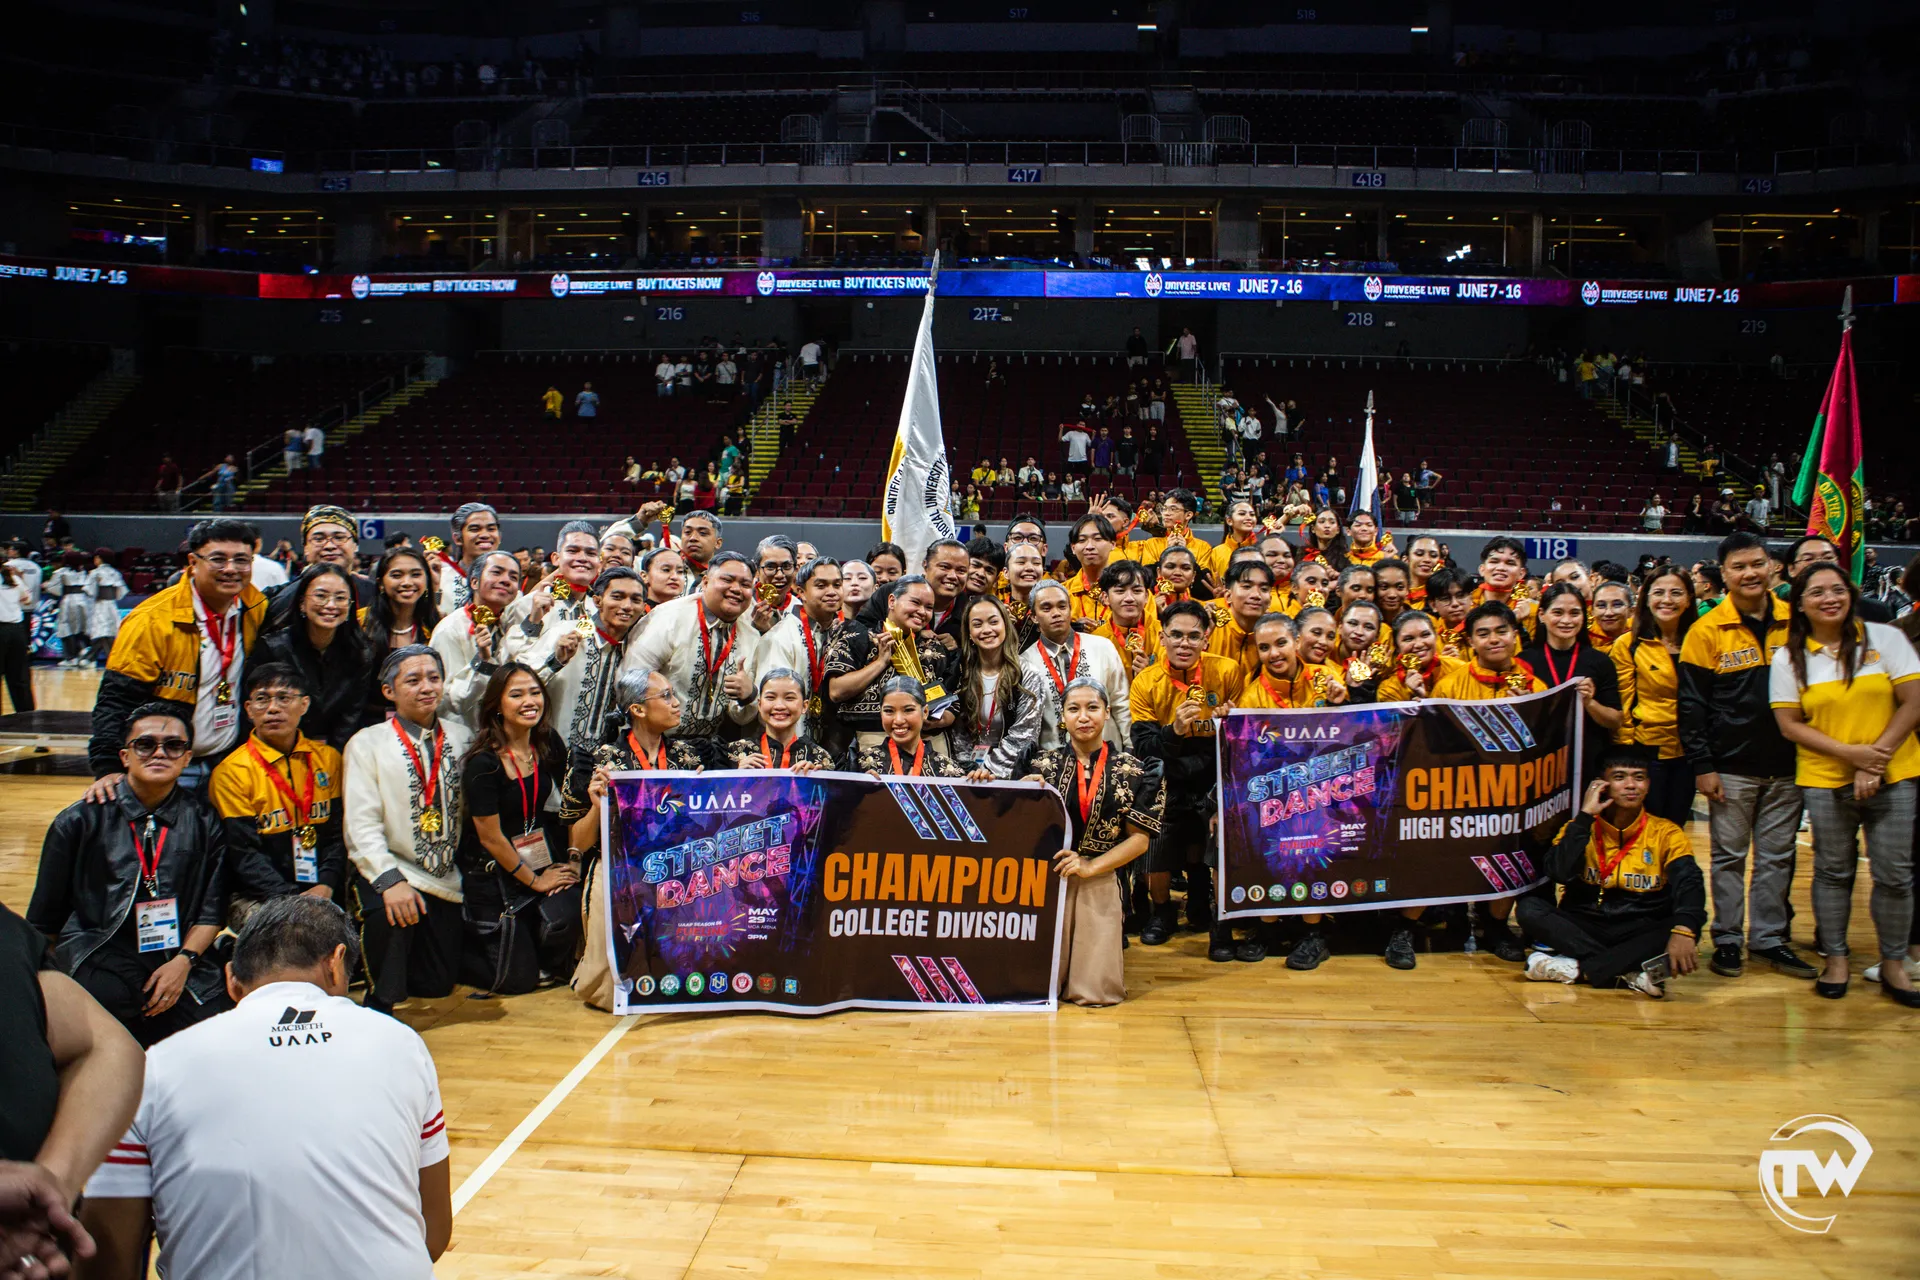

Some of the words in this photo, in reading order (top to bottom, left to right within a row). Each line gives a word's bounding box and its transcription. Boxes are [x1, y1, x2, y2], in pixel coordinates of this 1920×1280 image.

[640, 172, 667, 185] 416
[1011, 169, 1038, 183] 417
[1356, 173, 1383, 186] 418
[1745, 179, 1772, 193] 419
[53, 266, 90, 281] JUNE
[433, 279, 454, 292] BUY
[454, 279, 491, 292] TICKETS
[492, 279, 517, 292] NOW
[636, 277, 659, 290] BUY
[659, 277, 696, 290] TICKETS
[697, 277, 723, 290] NOW
[776, 279, 817, 288] UNIVERSE
[818, 279, 841, 288] LIVE!
[844, 277, 867, 289] BUY
[866, 277, 905, 289] TICKETS
[1164, 281, 1206, 291] UNIVERSE
[1208, 281, 1231, 292] LIVE!
[1237, 279, 1269, 293] JUNE
[1384, 285, 1426, 295] UNIVERSE
[1427, 286, 1450, 296] LIVE!
[1456, 283, 1488, 298] JUNE
[1602, 289, 1644, 299] UNIVERSE
[1645, 290, 1668, 300] LIVE!
[1674, 288, 1706, 303] JUNE
[657, 307, 683, 320] 216
[973, 307, 998, 321] 217
[1347, 312, 1374, 326] 218
[1741, 319, 1767, 333] 219
[925, 458, 946, 508] UNIVERSITY
[1828, 495, 1842, 518] THE
[929, 509, 951, 537] ROYAL
[1533, 539, 1569, 560] 118
[1284, 727, 1340, 739] UAAP
[1247, 740, 1374, 802] STREET
[1406, 745, 1569, 811] CHAMPION
[689, 793, 752, 810] UAAP
[1260, 765, 1376, 828] DANCE
[1399, 817, 1444, 841] HIGH
[1450, 812, 1522, 839] SCHOOL
[1525, 789, 1570, 830] DIVISION
[642, 812, 791, 884] STREET
[656, 843, 792, 909] DANCE
[823, 852, 1048, 907] CHAMPION
[1624, 873, 1661, 890] TOMA
[748, 908, 778, 916] MAY
[748, 916, 766, 924] 29
[829, 908, 929, 938] COLLEGE
[936, 911, 1037, 941] DIVISION
[676, 924, 729, 937] FUELING
[271, 1022, 324, 1033] MACBETH
[269, 1031, 333, 1047] UAAP
